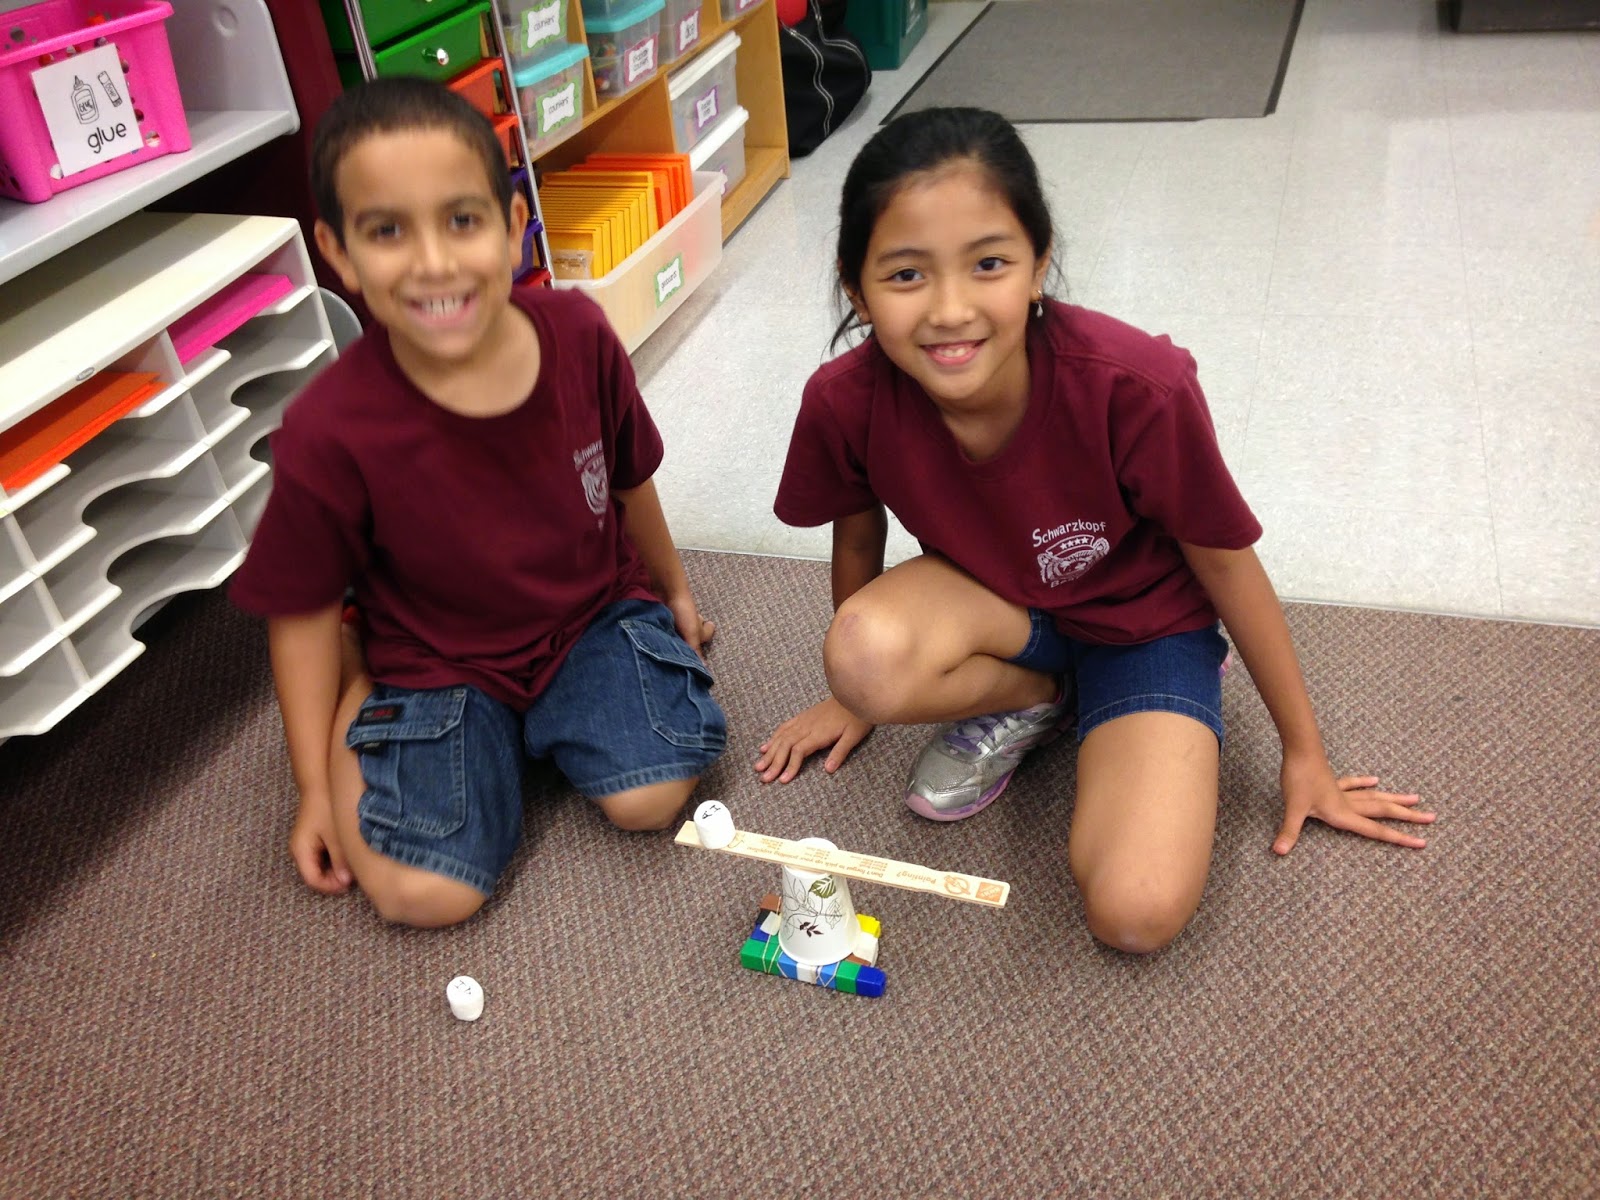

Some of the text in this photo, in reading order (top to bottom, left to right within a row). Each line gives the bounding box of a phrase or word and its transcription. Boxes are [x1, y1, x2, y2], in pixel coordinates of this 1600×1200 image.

[87, 123, 127, 154] glue
[1032, 519, 1106, 547] Schwarzkopf
[896, 870, 936, 884] Painting?
